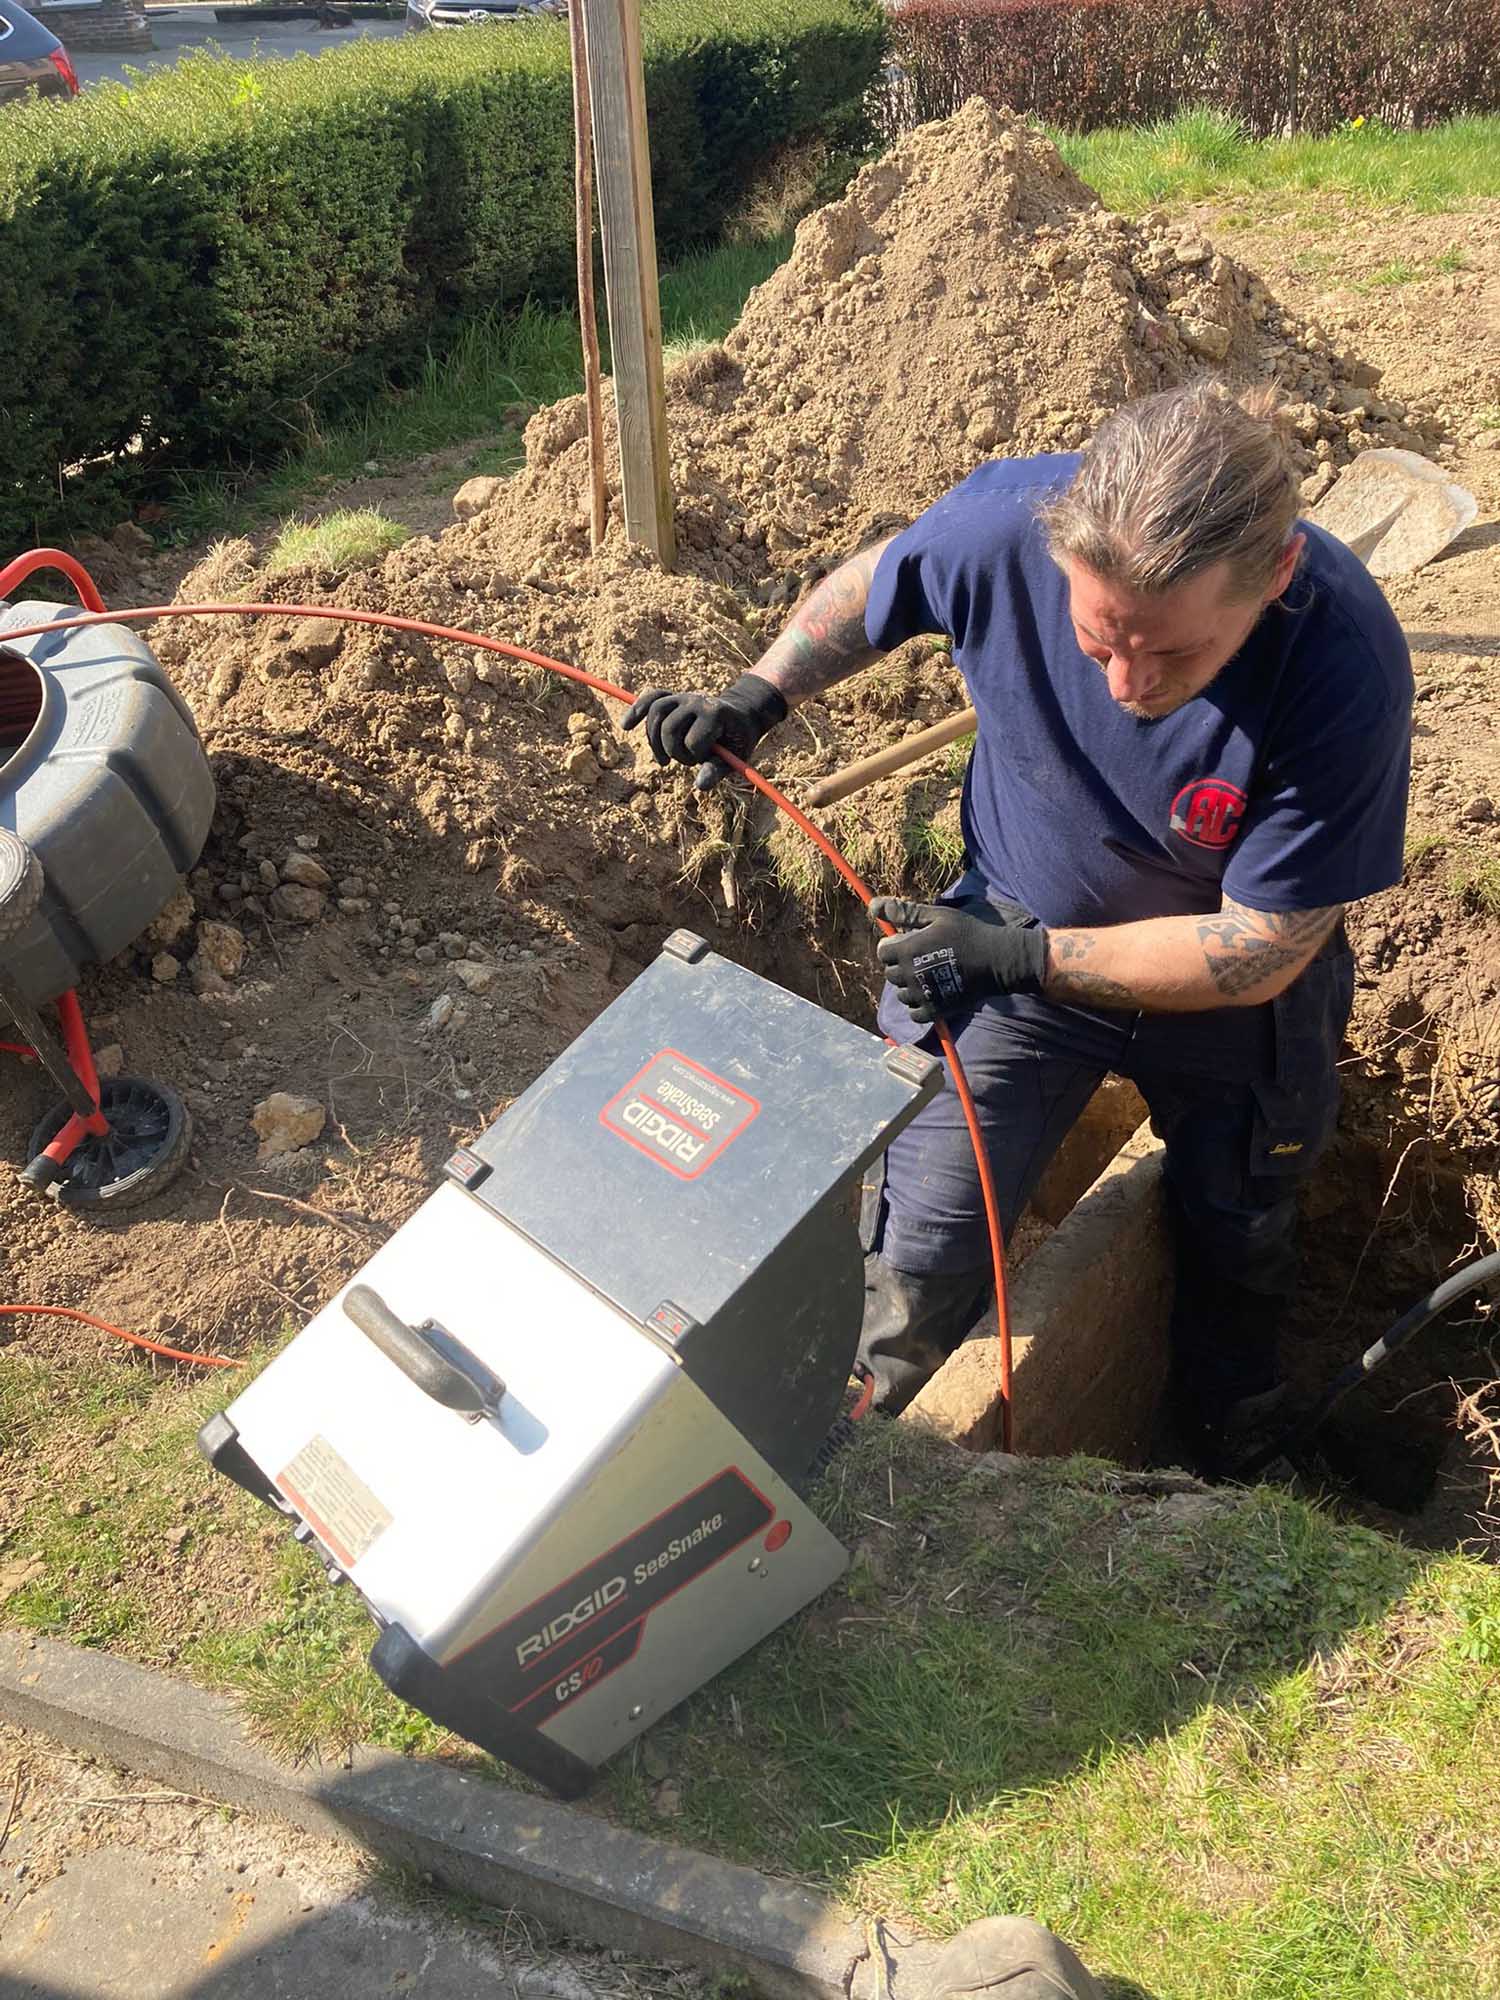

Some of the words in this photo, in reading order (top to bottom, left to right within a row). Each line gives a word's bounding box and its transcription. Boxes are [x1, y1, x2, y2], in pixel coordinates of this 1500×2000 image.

[622, 1101, 704, 1163] RIDGID
[656, 1081, 720, 1130] SeeSnake
[515, 1576, 627, 1666] RIDGID
[634, 1513, 723, 1585] SeeSnake
